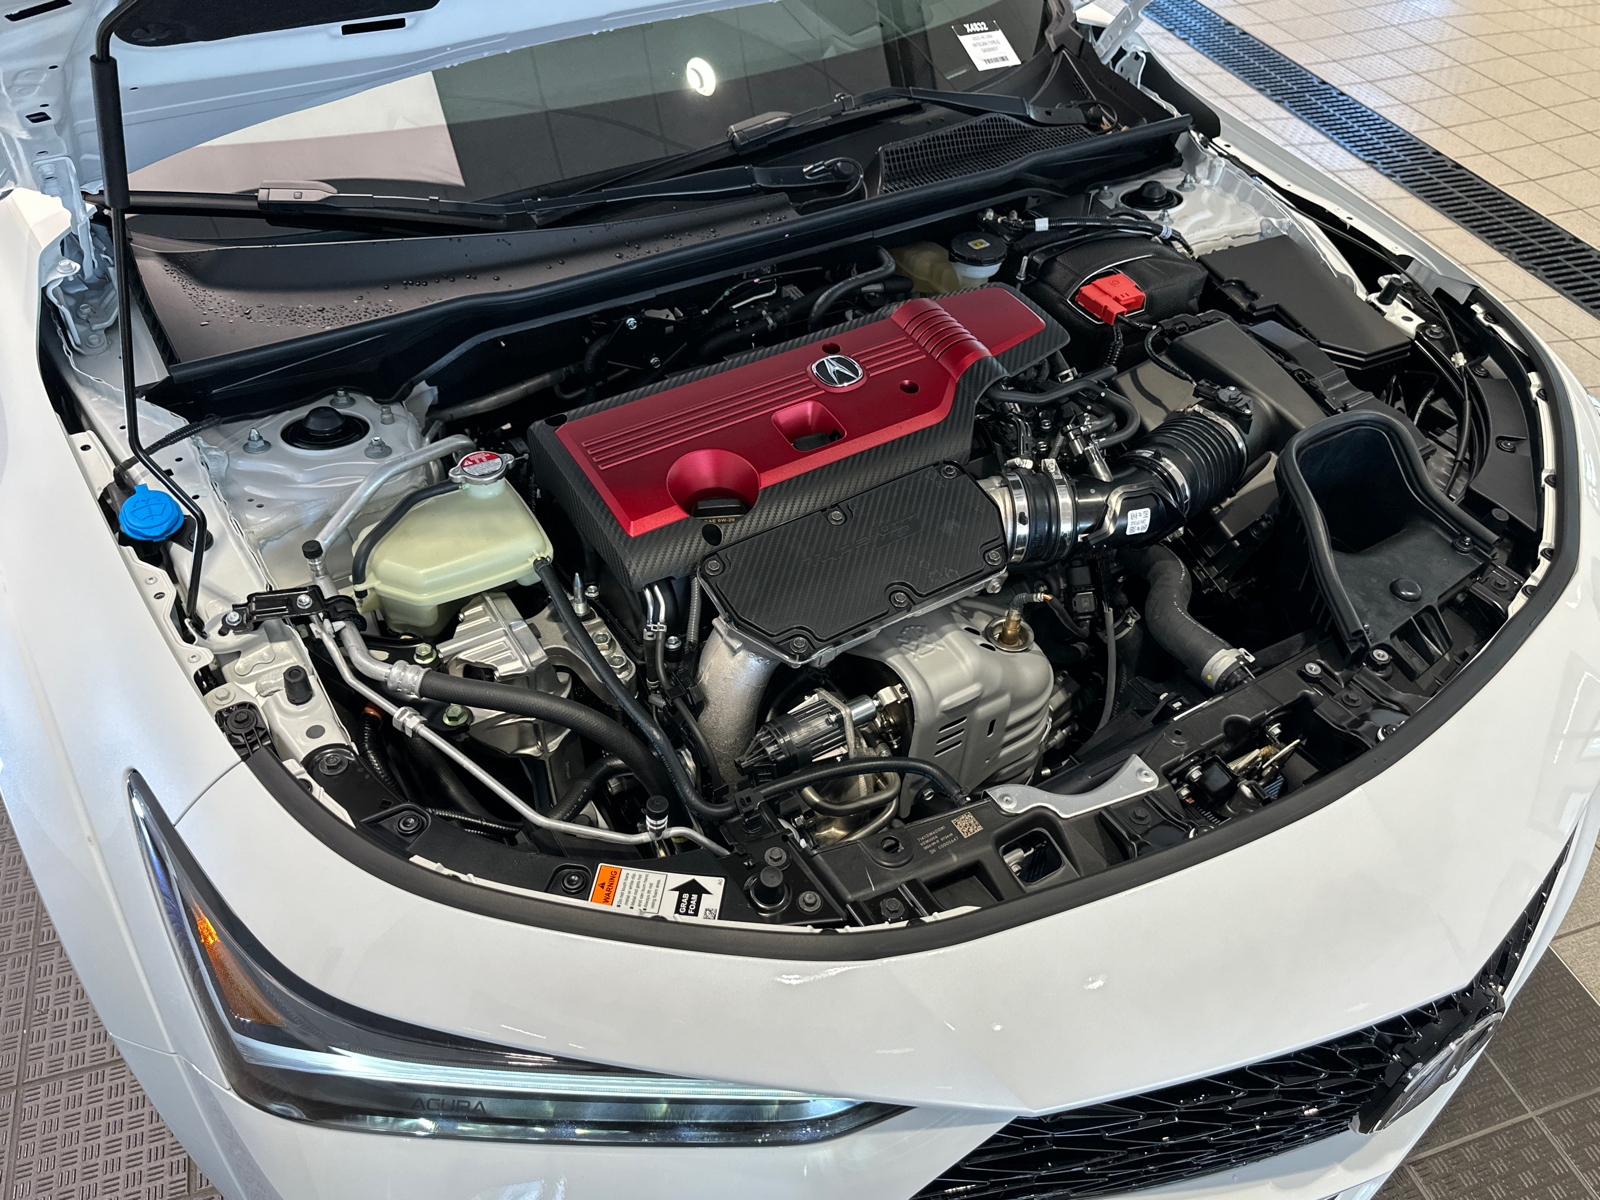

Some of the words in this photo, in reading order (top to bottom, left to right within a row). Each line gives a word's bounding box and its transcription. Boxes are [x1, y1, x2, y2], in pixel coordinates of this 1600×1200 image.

[603, 870, 617, 903] WARNING
[679, 893, 690, 914] GRAB
[687, 894, 699, 915] FOAM
[410, 1097, 487, 1114] ACURA
